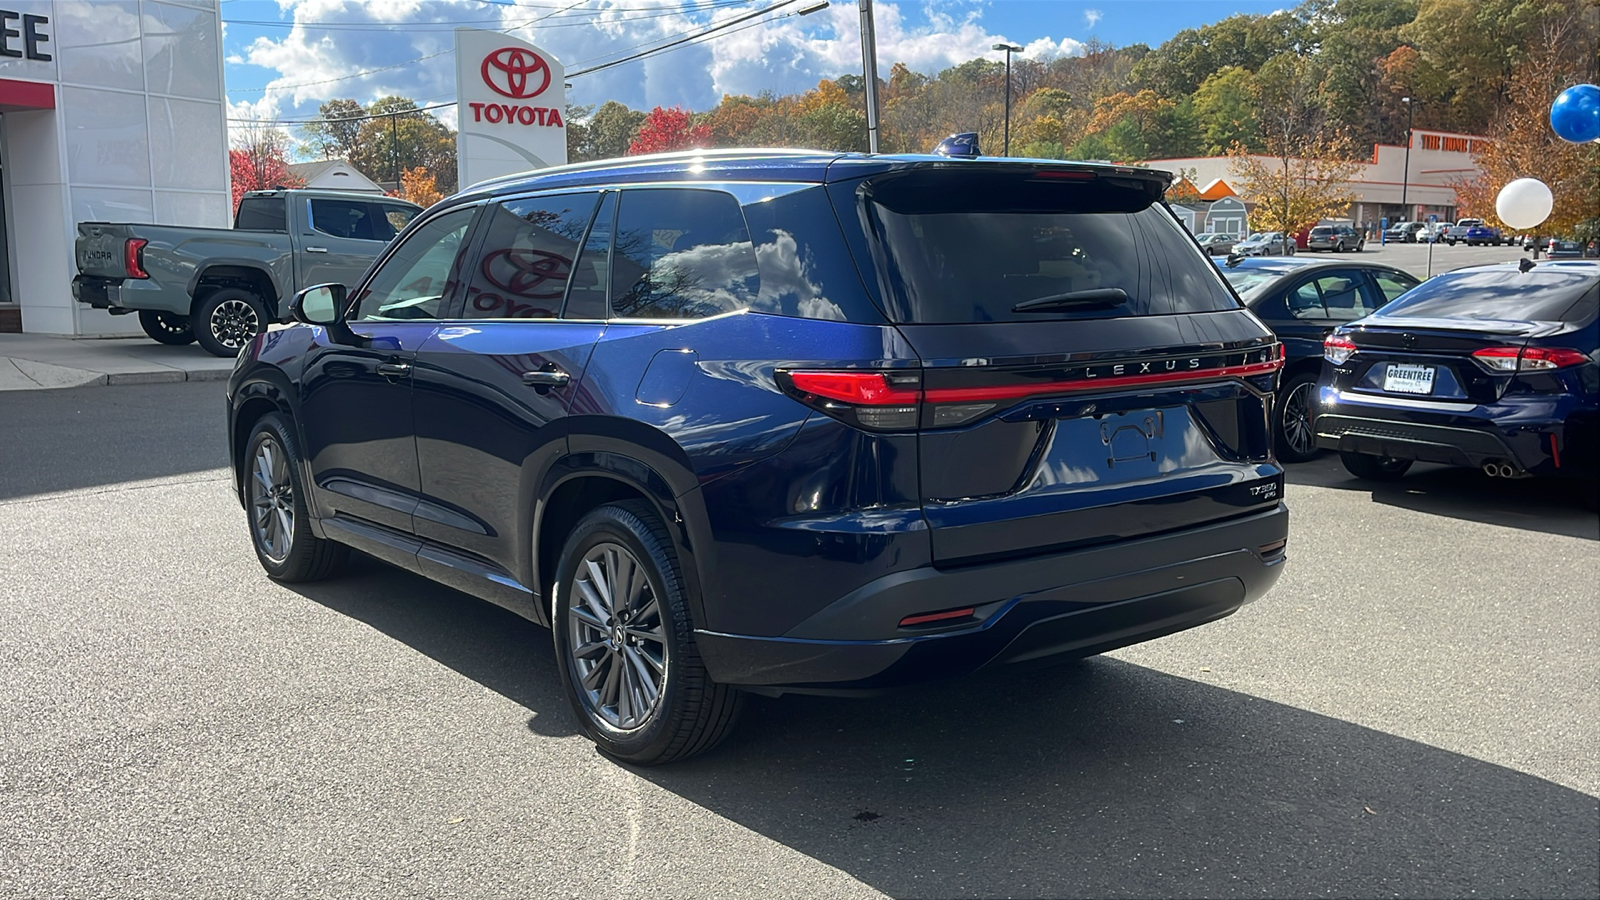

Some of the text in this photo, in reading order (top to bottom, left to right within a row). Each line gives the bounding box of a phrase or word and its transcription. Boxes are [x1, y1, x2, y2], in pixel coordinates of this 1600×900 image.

[0, 10, 52, 62] EE
[470, 103, 563, 127] TOYOTA
[1422, 134, 1440, 150] THE
[1442, 136, 1468, 153] HOME
[83, 250, 112, 261] TUNDRA
[1086, 358, 1200, 378] LEXUS
[1387, 369, 1432, 381] GREENTREE
